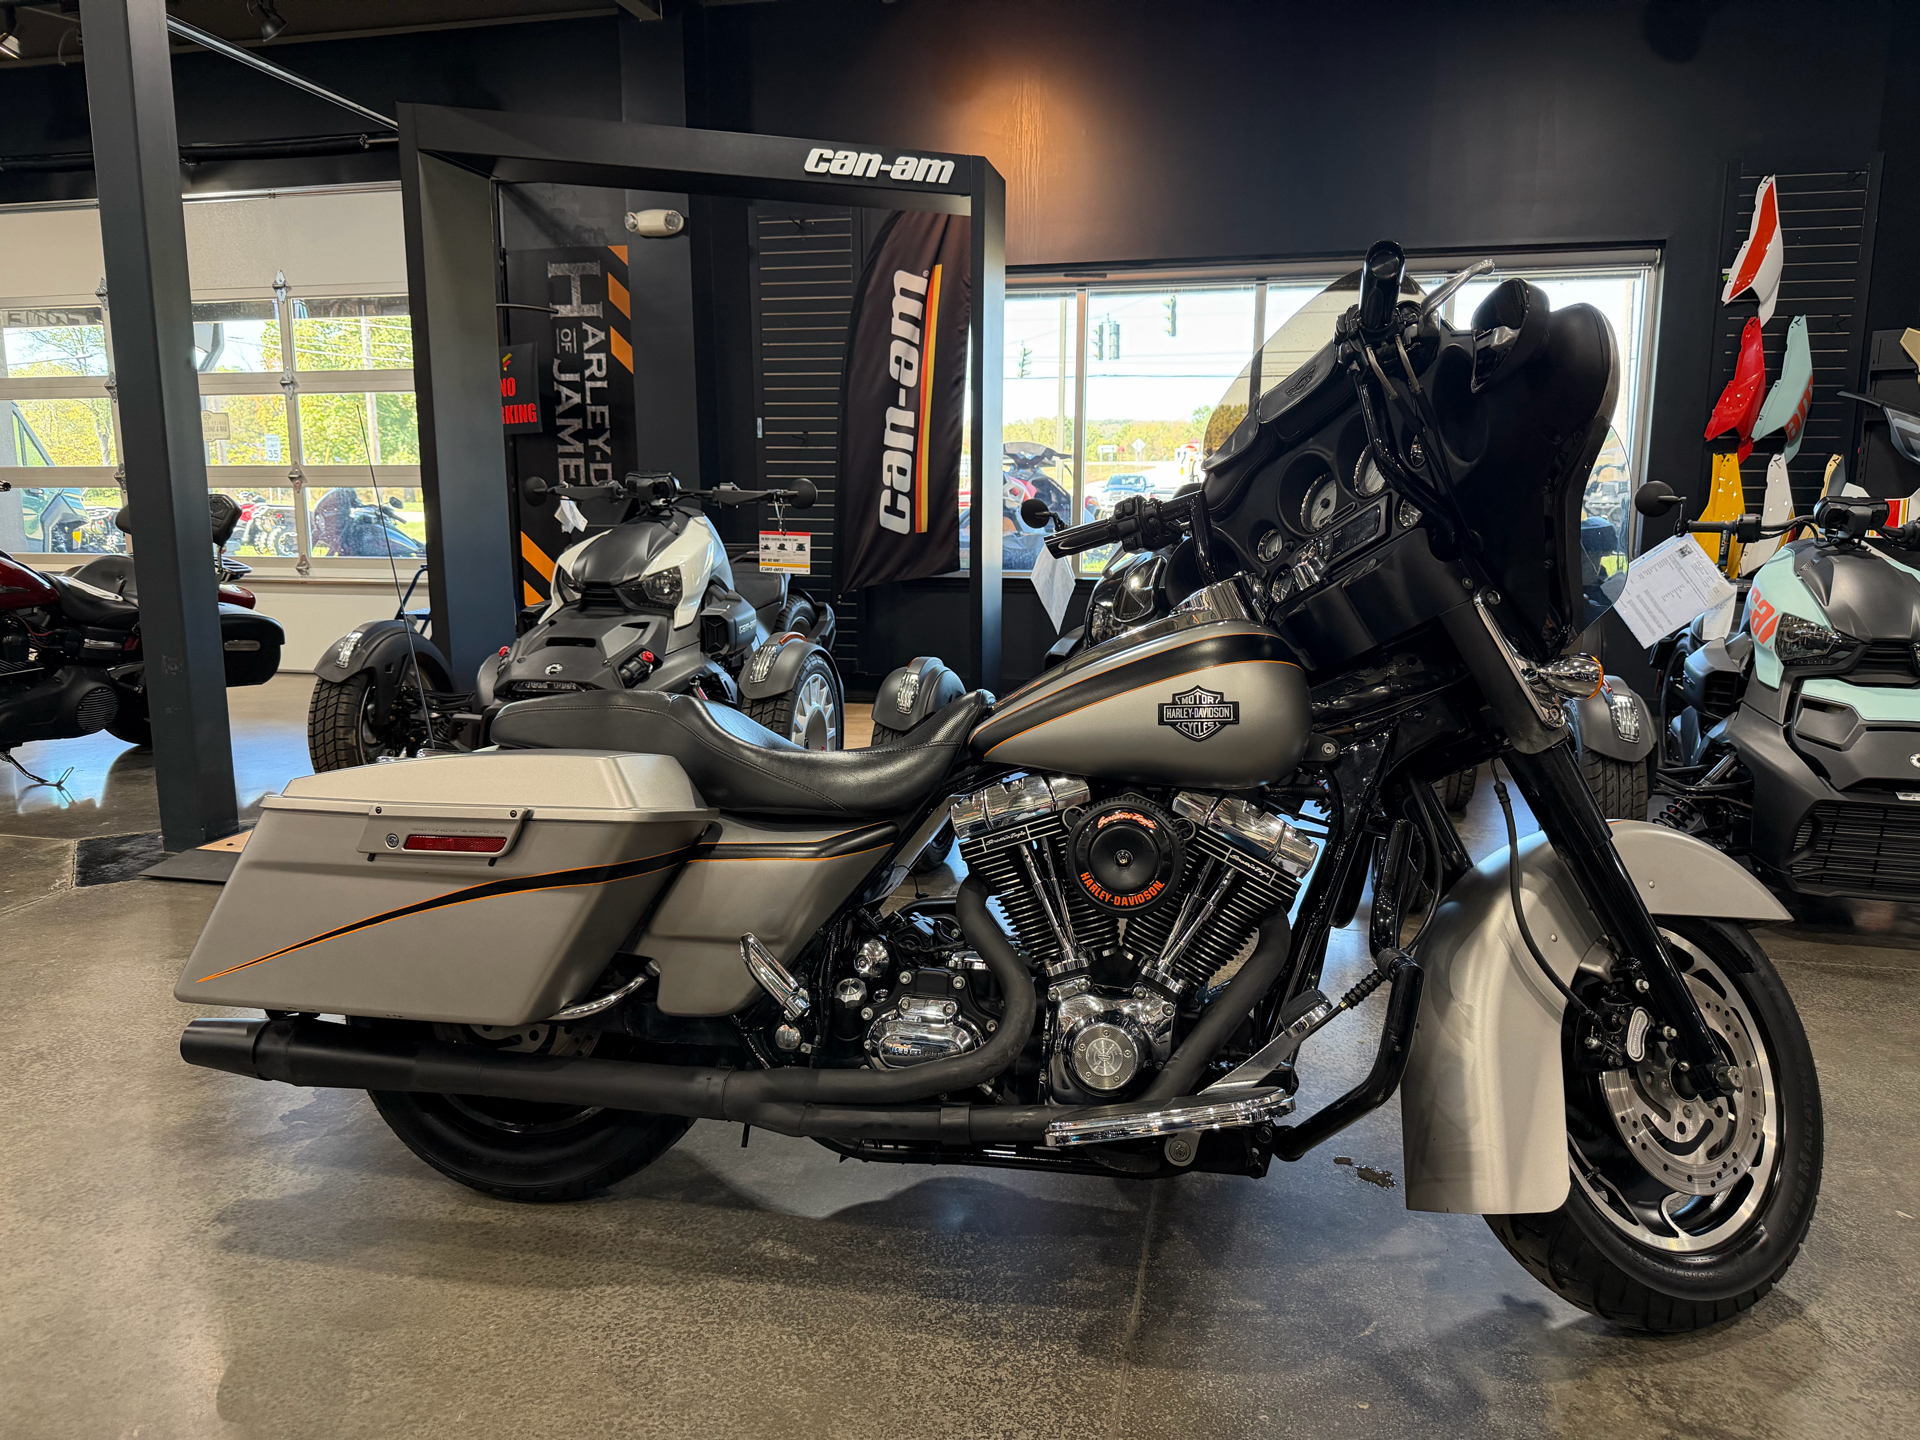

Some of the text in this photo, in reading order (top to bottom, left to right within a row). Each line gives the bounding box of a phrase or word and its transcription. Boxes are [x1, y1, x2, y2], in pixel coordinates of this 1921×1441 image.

[804, 148, 955, 184] can-am
[560, 328, 574, 354] OF
[500, 377, 516, 397] NO
[879, 269, 929, 535] can-am
[268, 449, 280, 459] 35
[1181, 691, 1214, 705] MOTOR
[1166, 706, 1230, 719] HARLEY-DAVIDSON
[1181, 721, 1215, 736] CYCLES
[1080, 871, 1165, 907] HARLEY-DAVIDSON
